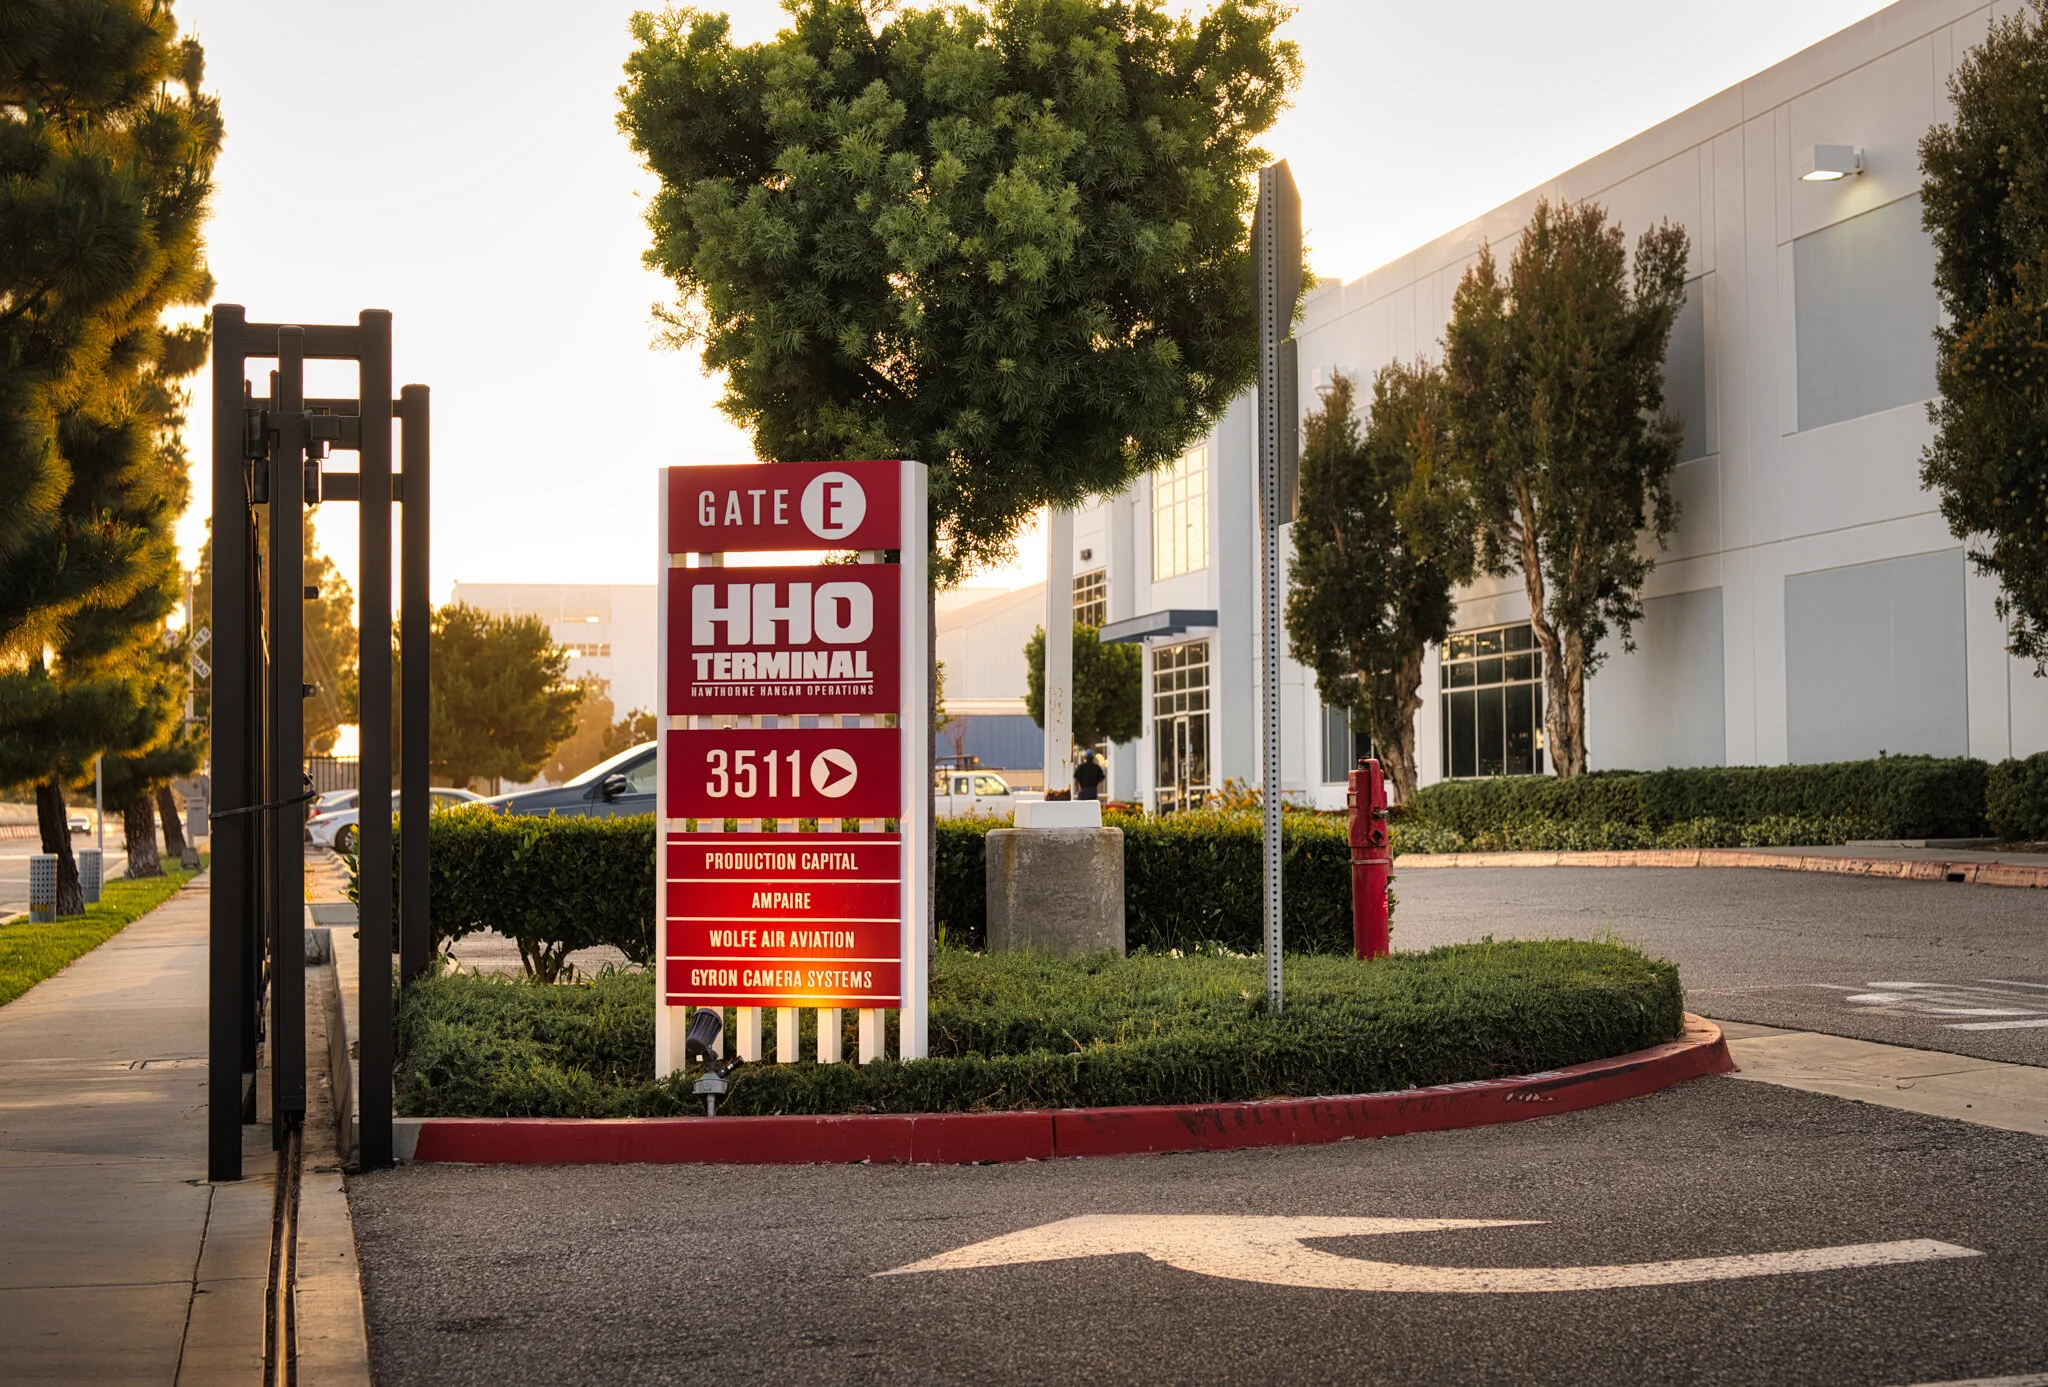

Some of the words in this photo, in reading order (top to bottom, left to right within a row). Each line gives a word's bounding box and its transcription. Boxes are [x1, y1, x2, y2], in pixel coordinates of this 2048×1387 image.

[698, 489, 789, 526] GATE
[822, 481, 843, 530] E
[691, 581, 874, 646] HHO
[691, 650, 874, 681] TERMINAL
[691, 686, 755, 697] HAWTHORNE
[760, 685, 801, 697] HANGAR
[807, 684, 874, 696] OPERATIONS
[706, 749, 801, 798] 3511
[705, 852, 796, 871] PRODUCTION
[801, 852, 859, 871] CAPITAL
[751, 892, 811, 909] AMPAIRE
[709, 930, 757, 948] WOLFE
[761, 930, 785, 948] AIR
[789, 930, 855, 948] AVIATION
[691, 968, 738, 987] GYRON
[743, 969, 802, 987] CAMERA
[807, 970, 873, 989] SYSTEMS
